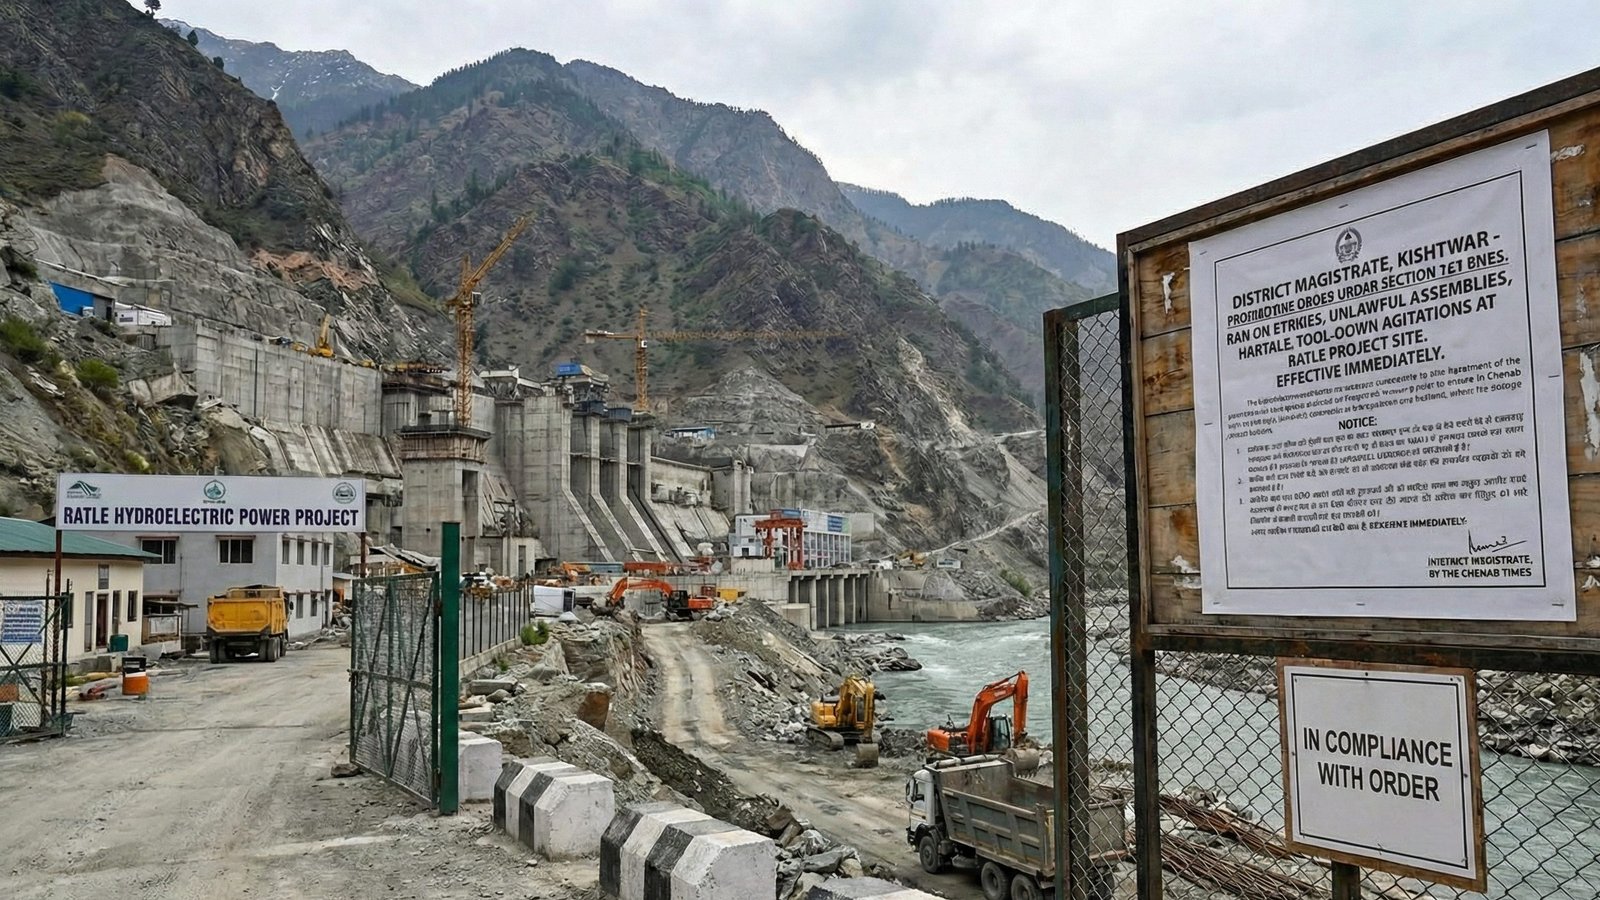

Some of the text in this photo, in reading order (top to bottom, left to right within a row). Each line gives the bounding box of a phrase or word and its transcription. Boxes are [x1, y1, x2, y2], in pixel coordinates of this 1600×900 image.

[1233, 281, 1291, 309] DISTRICT
[1295, 256, 1393, 294] MAGISTRATE,
[1398, 231, 1489, 267] KISHTWAR
[1337, 280, 1378, 301] URDAR
[1381, 266, 1436, 289] SECTION
[1467, 249, 1508, 269] BNES.
[1227, 329, 1250, 346] RAN
[1253, 324, 1270, 340] ON
[1329, 294, 1406, 322] UNLAWFUL
[1409, 270, 1513, 305] ASSEMBLIES,
[1382, 299, 1472, 330] AGITATIONS
[1475, 294, 1497, 312] AT
[1277, 346, 1445, 388] EFFECTIVE IMMEDIATELY.
[1288, 329, 1428, 368] RATLE PROJECT SITE.
[1494, 358, 1503, 368] of
[1505, 357, 1521, 365] the
[1487, 368, 1521, 381] Chenab
[1338, 416, 1378, 431] NOTICE:
[63, 506, 359, 526] RATLE HYDROELECTRIC POWER PROJECT
[1429, 568, 1532, 579] BY THE CHENAB TIMES
[1303, 727, 1453, 768] IN COMPLIANCE
[1317, 761, 1440, 802] WITH ORDER
